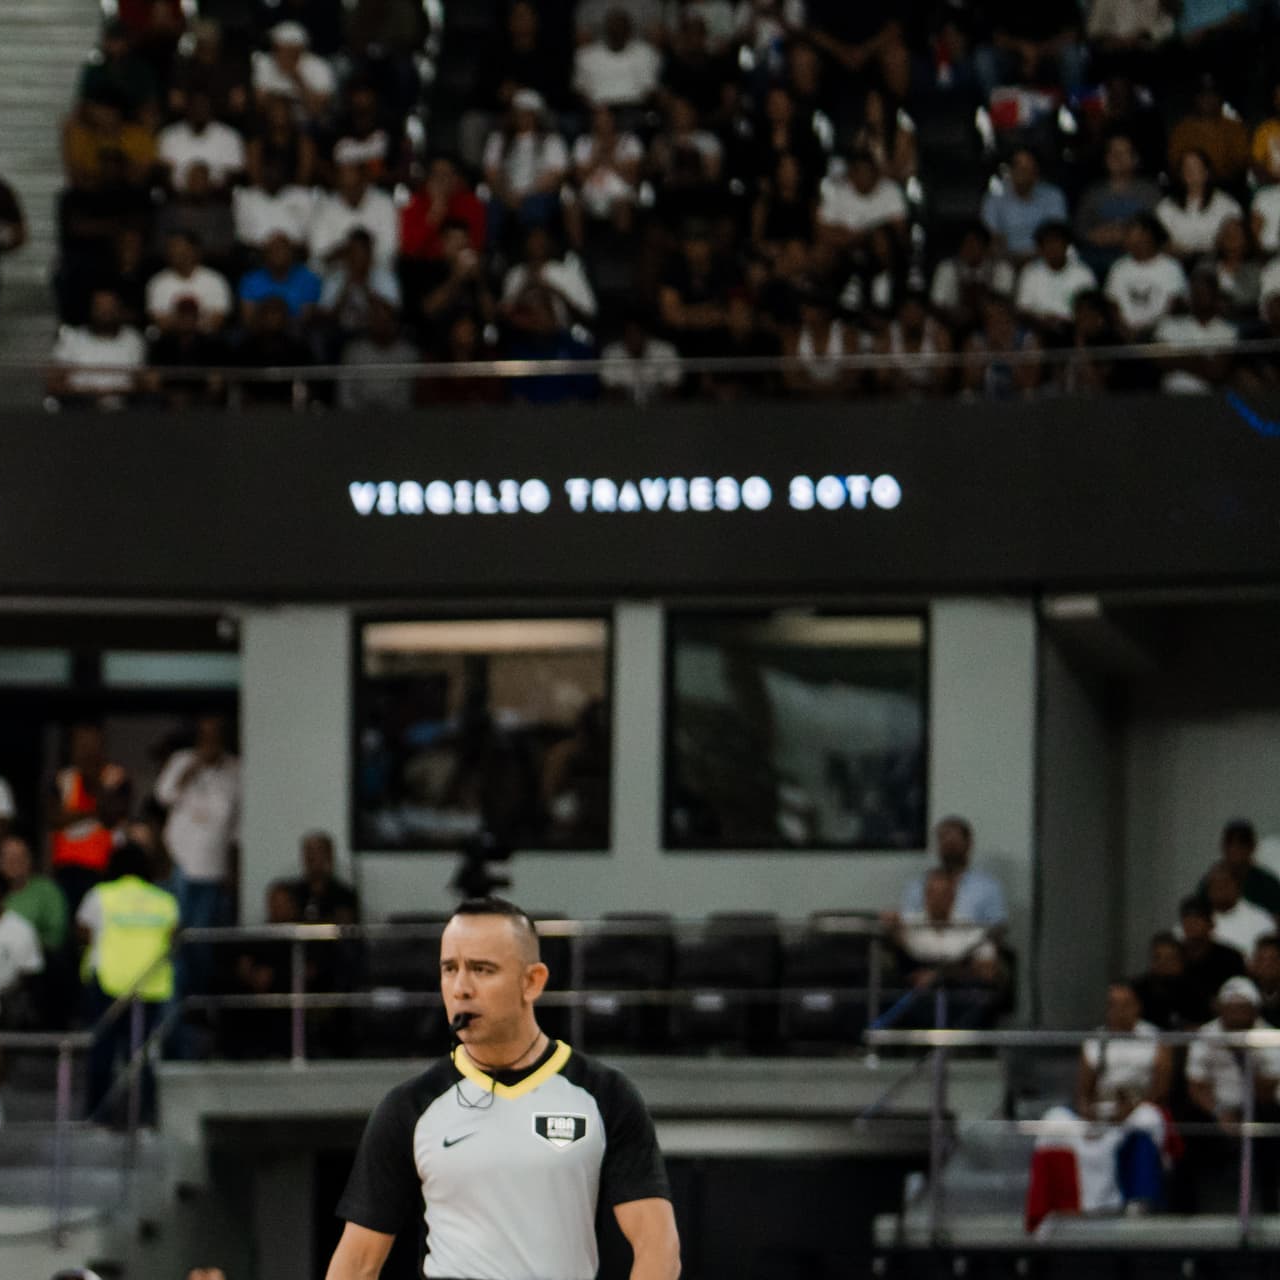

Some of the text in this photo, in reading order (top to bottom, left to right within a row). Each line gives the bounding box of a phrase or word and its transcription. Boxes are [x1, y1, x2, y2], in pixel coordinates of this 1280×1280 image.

[348, 473, 902, 516] VIRGILIO TRAVIESO SOTO
